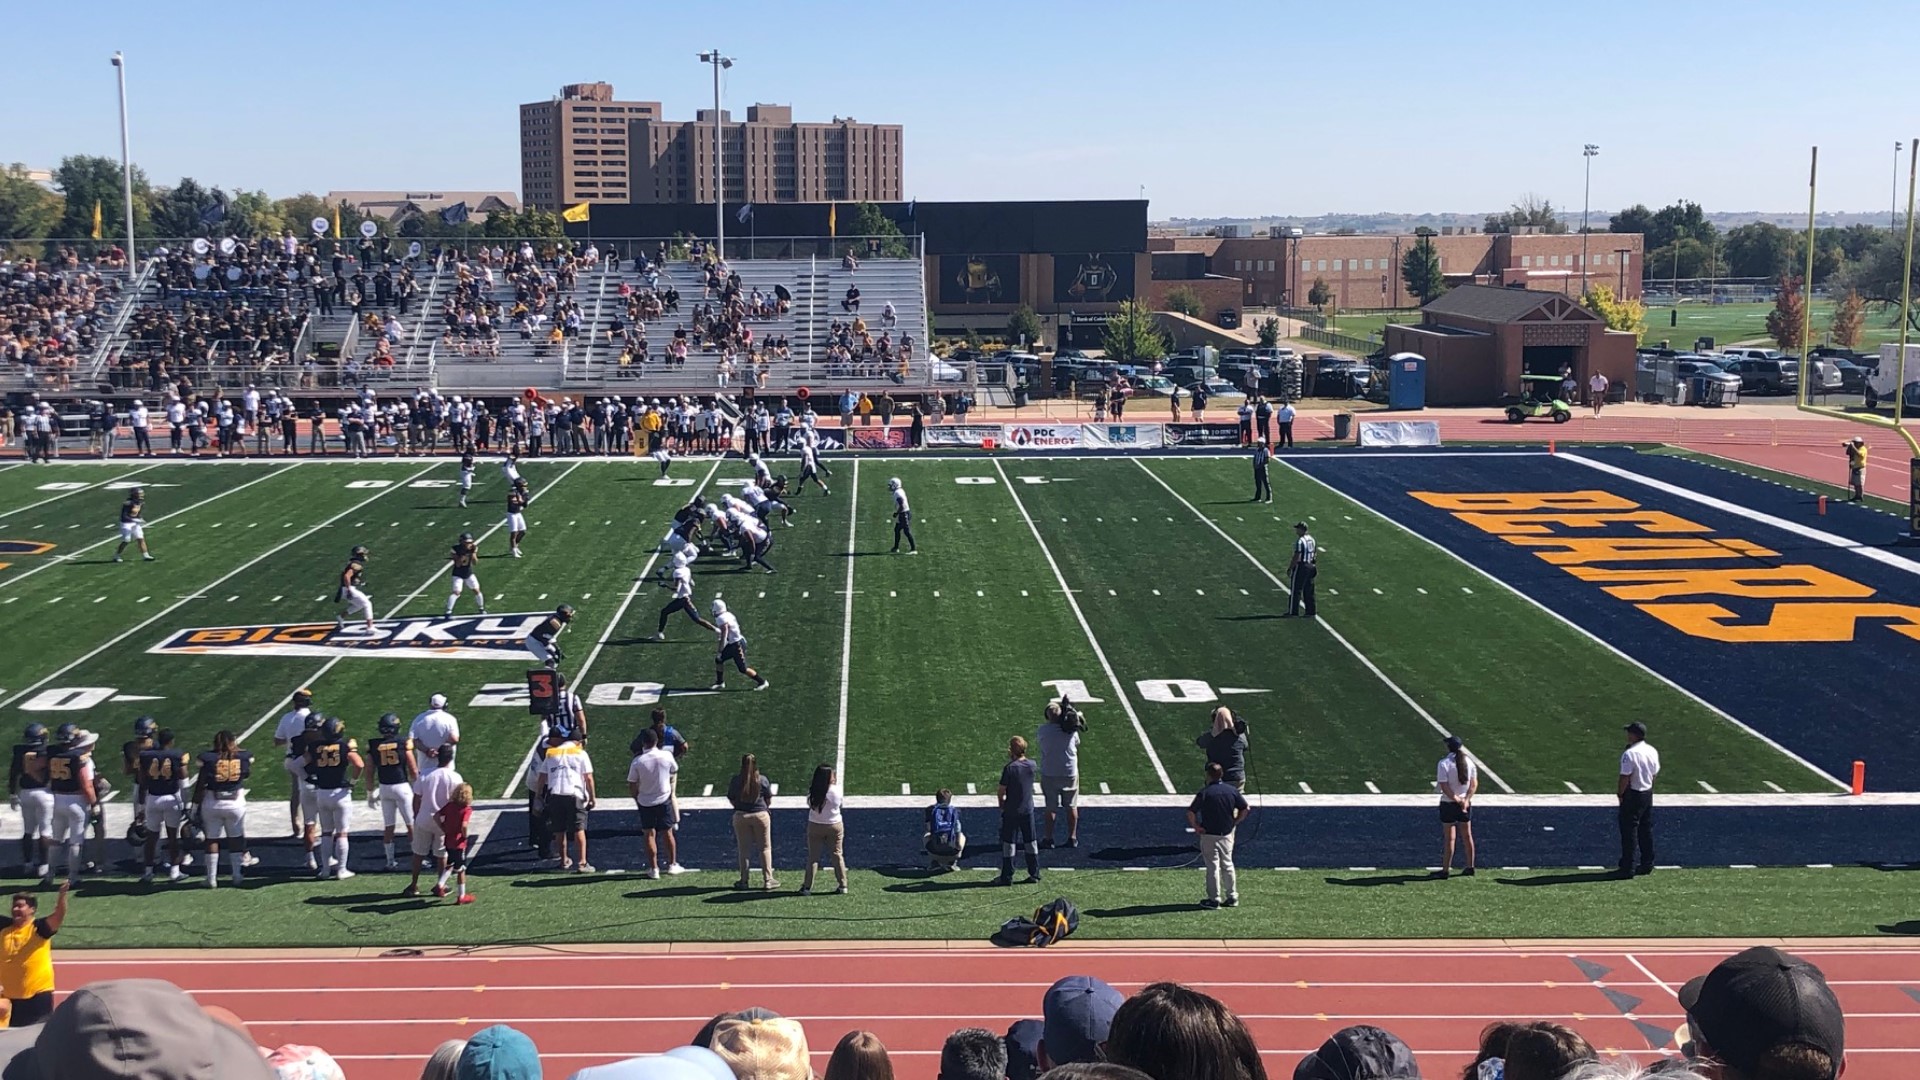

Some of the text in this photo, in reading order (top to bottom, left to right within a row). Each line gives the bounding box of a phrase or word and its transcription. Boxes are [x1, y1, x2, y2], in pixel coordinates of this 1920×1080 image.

[1034, 429, 1055, 437] PDC
[1034, 437, 1076, 446] ENERGY
[1406, 490, 1920, 643] BEARS
[187, 615, 549, 642] BIG SKY
[531, 674, 553, 698] 3
[316, 743, 341, 767] 33
[377, 742, 400, 767] 15
[149, 757, 173, 780] 44
